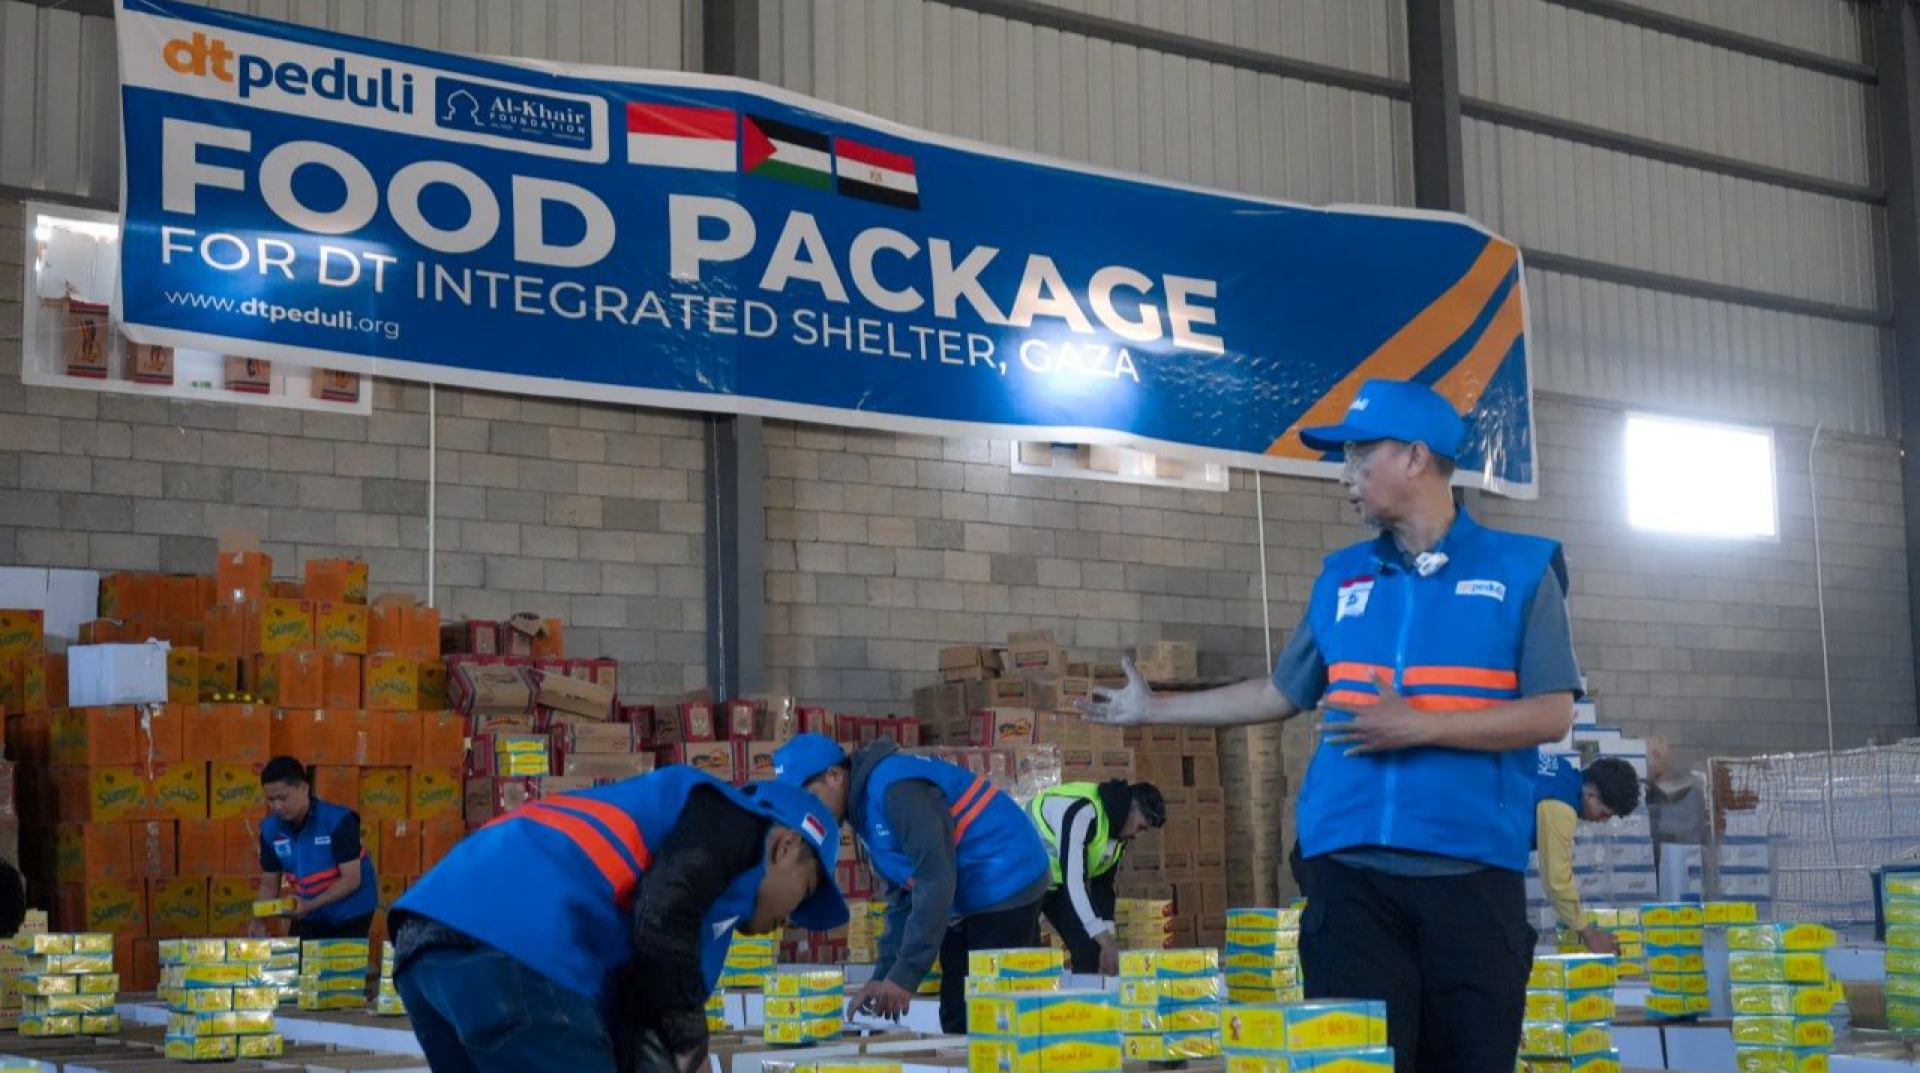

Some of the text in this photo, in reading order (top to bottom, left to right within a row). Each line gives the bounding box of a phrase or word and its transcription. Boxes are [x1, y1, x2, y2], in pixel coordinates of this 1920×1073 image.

[162, 31, 414, 115] dtpeduli
[489, 112, 586, 135] FOUNDATION
[491, 96, 586, 124] Al-Khair
[161, 116, 1225, 355] FOOD PACKAGE
[161, 225, 1140, 382] FOR DT INTEGRATED SHELTER, GAZA
[165, 290, 400, 340] www.dtpeduli.org
